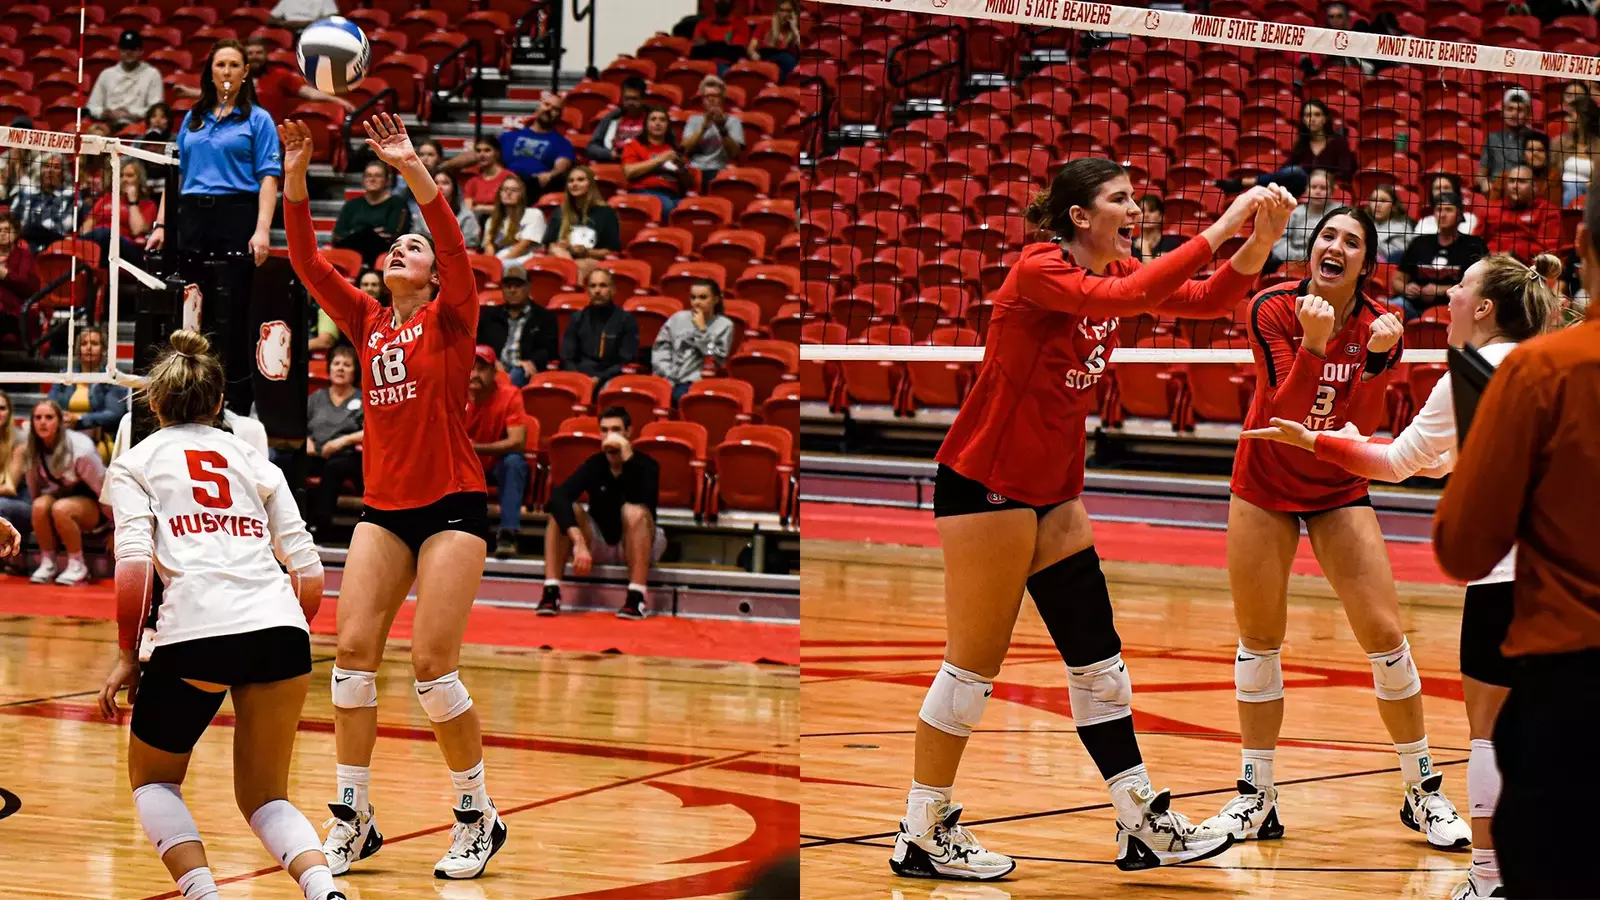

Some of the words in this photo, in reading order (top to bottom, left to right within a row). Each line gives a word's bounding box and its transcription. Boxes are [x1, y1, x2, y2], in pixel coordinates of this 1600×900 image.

[984, 0, 1020, 15] MINOT
[1025, 0, 1058, 19] STATE
[1062, 1, 1112, 25] BEAVERS
[1191, 15, 1226, 38] MINOT
[1227, 19, 1258, 41] STATE
[1260, 23, 1305, 46] BEAVERS
[1376, 36, 1407, 56] MINOT
[1408, 39, 1435, 59] STATE
[1438, 42, 1478, 64] BEAVERS
[1540, 53, 1568, 72] MINOT
[1568, 56, 1594, 75] STATE
[8, 129, 27, 144] MINOT
[28, 131, 47, 147] STATE
[371, 347, 407, 387] 18
[1084, 344, 1106, 374] 6
[369, 380, 417, 406] STATE
[1310, 384, 1336, 416] 3
[184, 450, 233, 509] 5
[168, 512, 264, 538] HUSKIES
